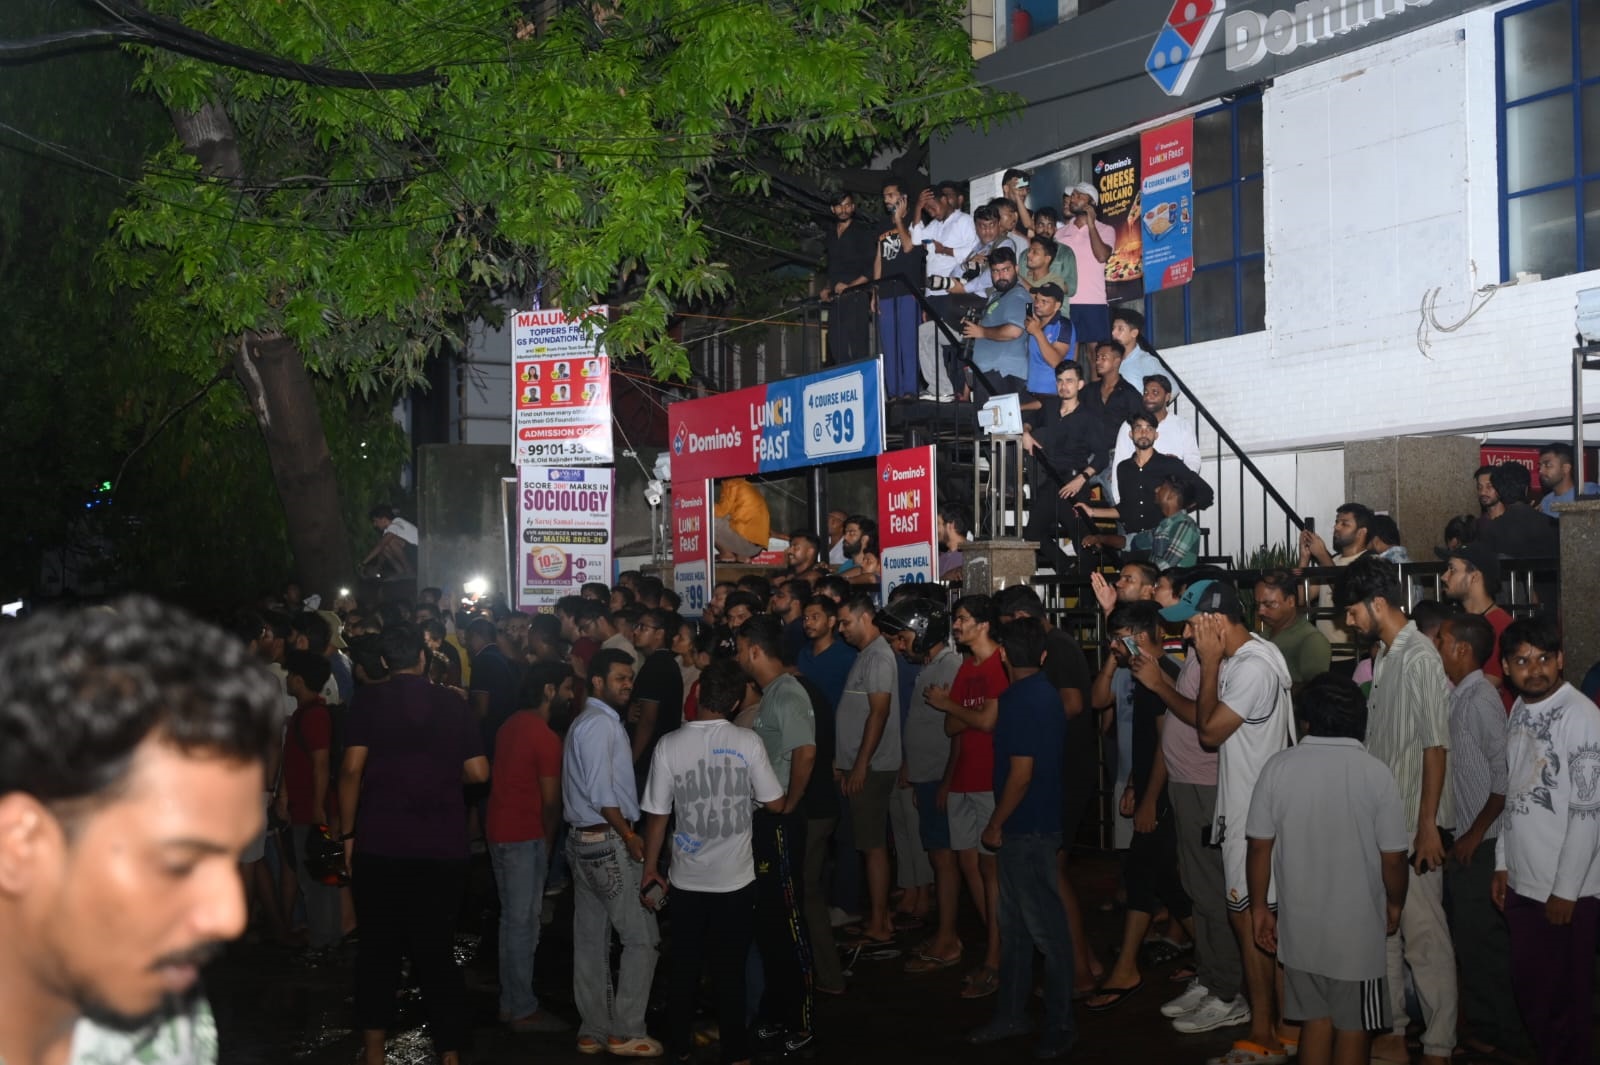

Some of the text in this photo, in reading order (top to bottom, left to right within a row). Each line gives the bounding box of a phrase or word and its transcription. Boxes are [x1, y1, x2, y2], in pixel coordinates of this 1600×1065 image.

[1226, 0, 1433, 72] Domin
[1104, 157, 1132, 172] Domino's
[1100, 167, 1135, 192] CHEESE
[1100, 185, 1133, 205] VOLCANO
[518, 312, 578, 327] MALUK
[530, 327, 566, 336] TOPPERS
[529, 335, 577, 345] FOUNDATION
[808, 389, 858, 408] 4 COURSE MEAL
[525, 429, 575, 438] ADMISSION
[688, 426, 742, 453] Domino's
[813, 423, 823, 441] @
[528, 443, 591, 455] 99101-33
[1486, 454, 1533, 470] Vaiam
[892, 465, 925, 480] Domino's
[524, 489, 608, 512] SOCIOLOGY
[681, 496, 702, 508] Domino's
[527, 518, 533, 526] by
[884, 556, 928, 569] 4 COURSE MEAL
[680, 573, 694, 581] COURSE
[695, 571, 704, 580] MEAL
[538, 606, 555, 614] 959
